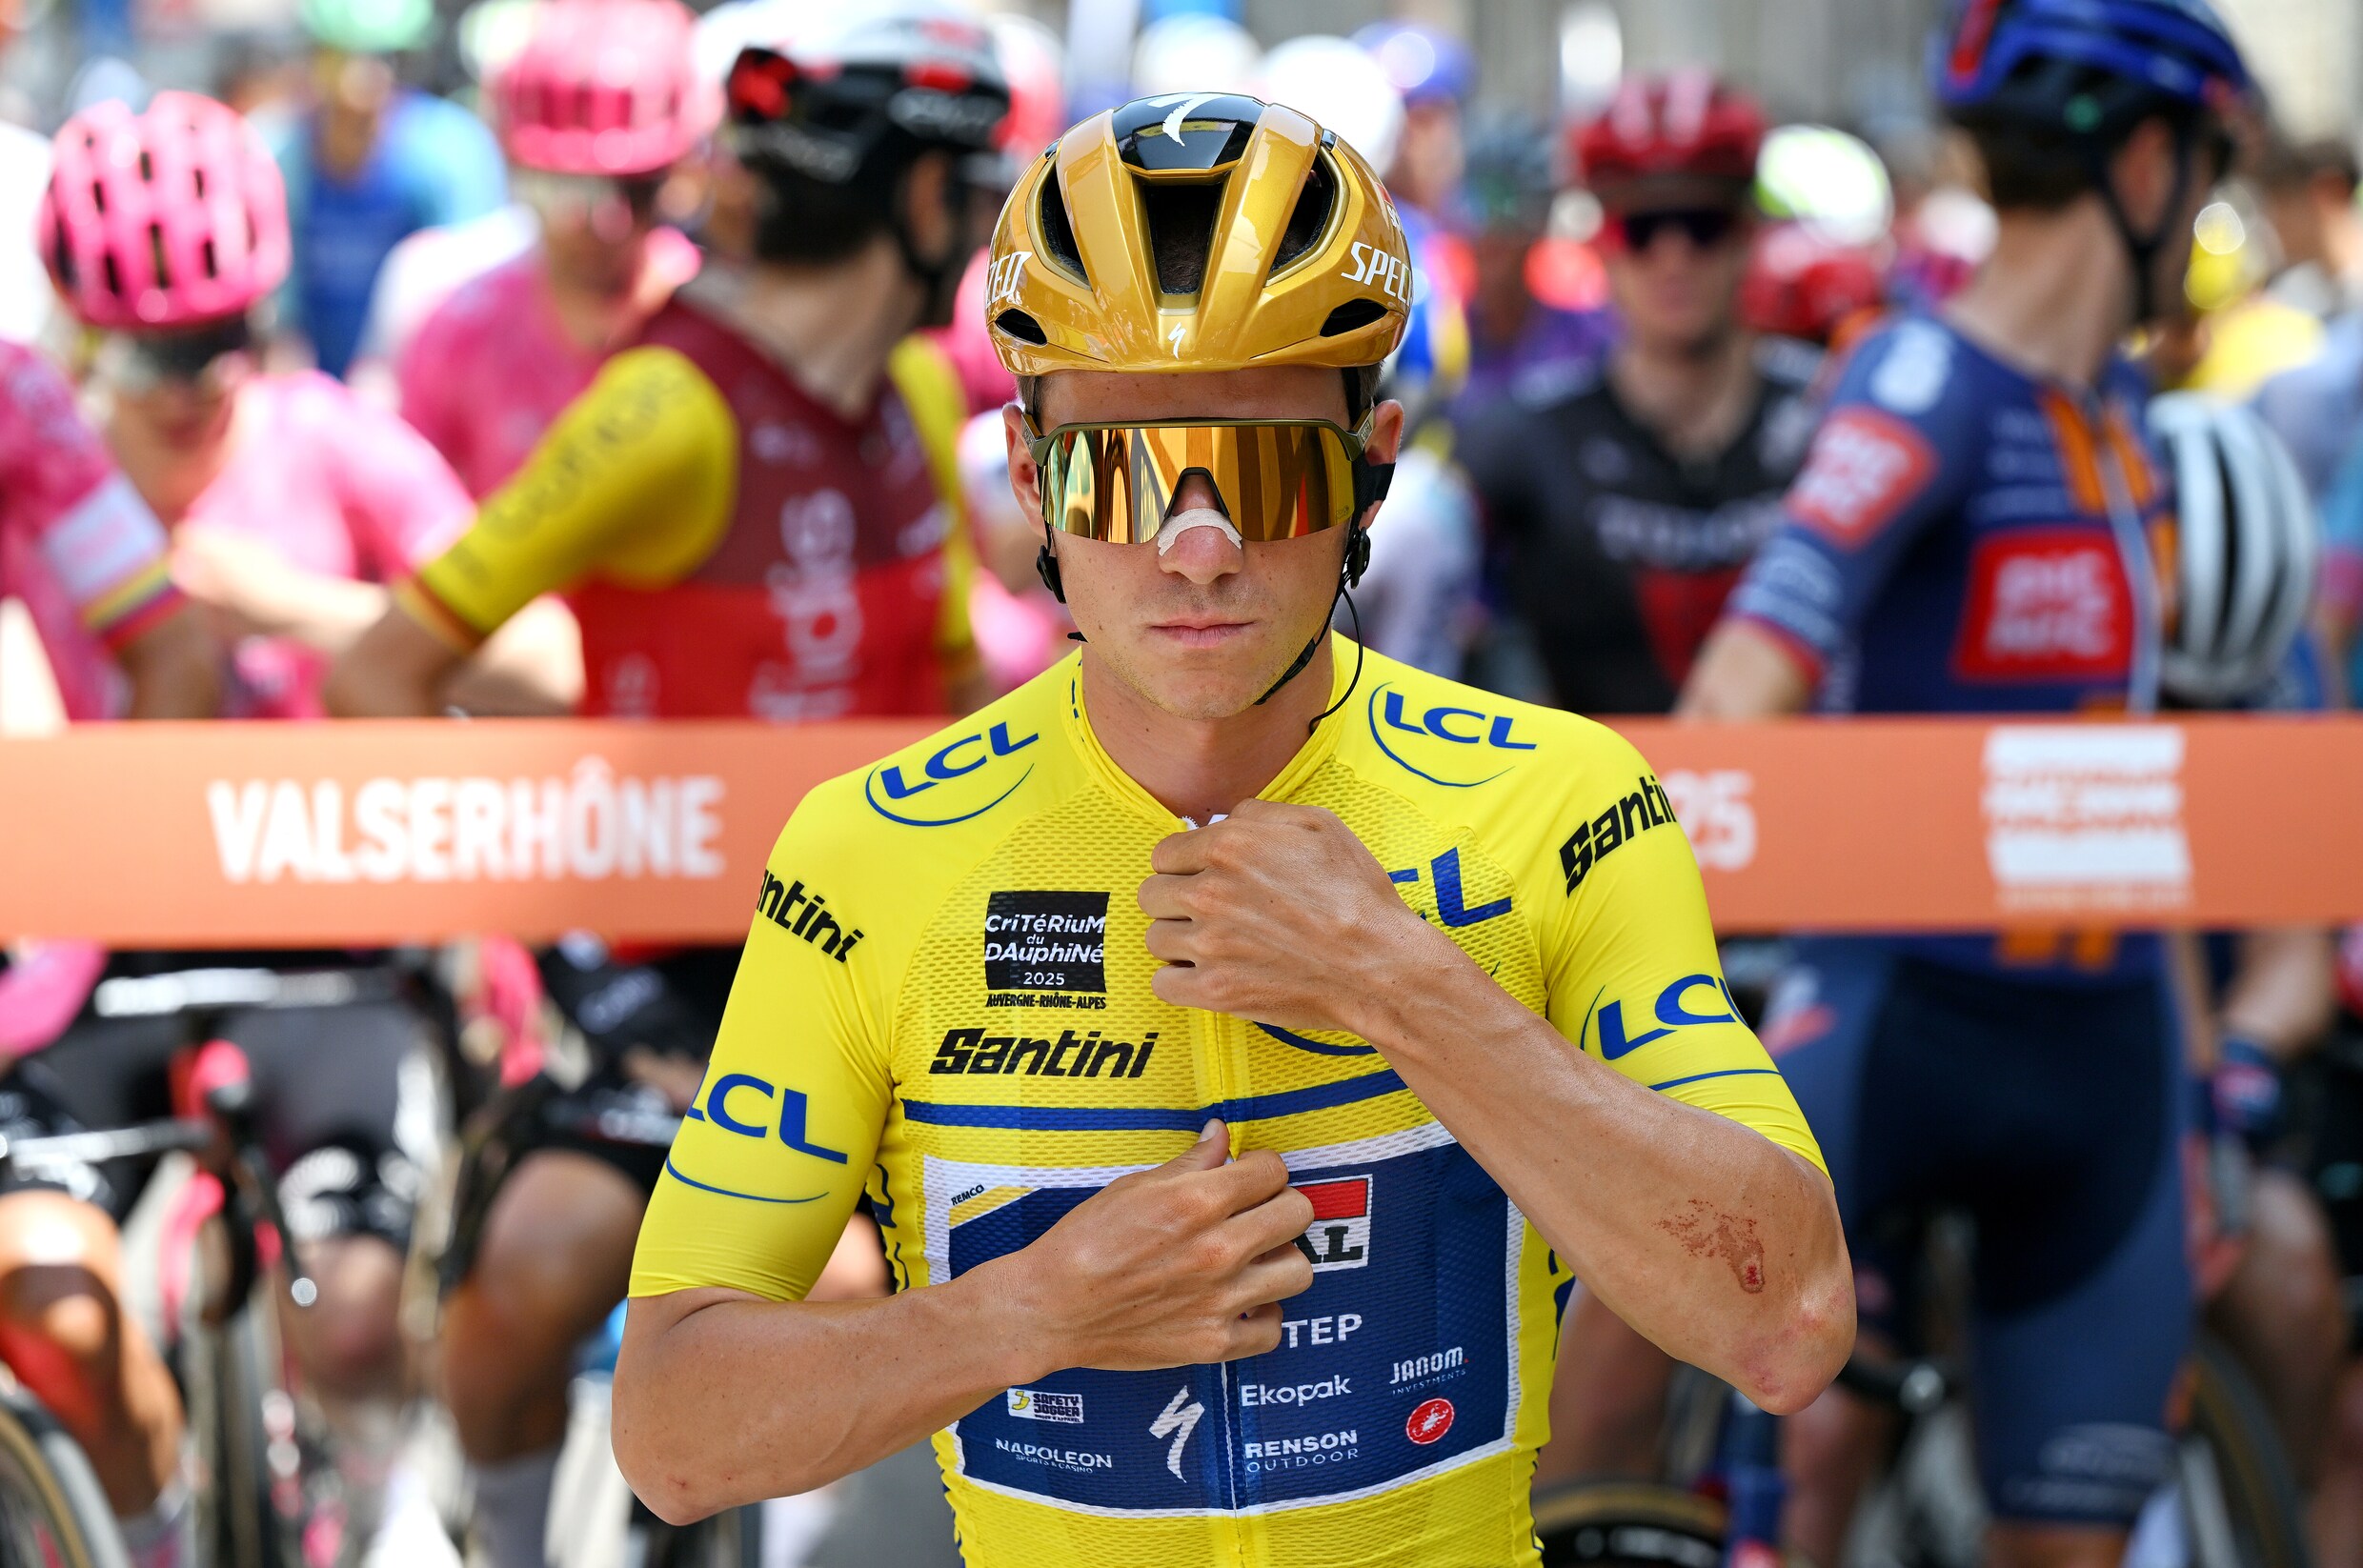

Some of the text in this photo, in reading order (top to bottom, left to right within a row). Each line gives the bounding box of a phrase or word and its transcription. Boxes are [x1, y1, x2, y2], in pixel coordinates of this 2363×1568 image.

[1384, 691, 1537, 750] LCL
[880, 721, 1040, 799] LCL
[206, 753, 727, 884] VALSERHÔNE
[756, 868, 864, 963] ntini
[1026, 934, 1045, 945] du
[1022, 972, 1065, 986] 2025
[985, 992, 1107, 1010] AUVERGNE-RHÔNE-ALPES
[1598, 974, 1749, 1061] LC
[928, 1028, 1160, 1078] Santini
[951, 1184, 985, 1206] REMCO
[1241, 1374, 1353, 1407] Ekopak
[1392, 1368, 1466, 1396] INVESTMENTS
[1033, 1393, 1079, 1406] SAFETY
[1033, 1403, 1081, 1417] JOGGER
[996, 1437, 1112, 1469] NAPOLEON
[1244, 1429, 1359, 1459] RENSON
[1016, 1454, 1049, 1466] SPORTS
[1059, 1462, 1093, 1474] CASINO
[1245, 1448, 1360, 1474] OUTDOOR
